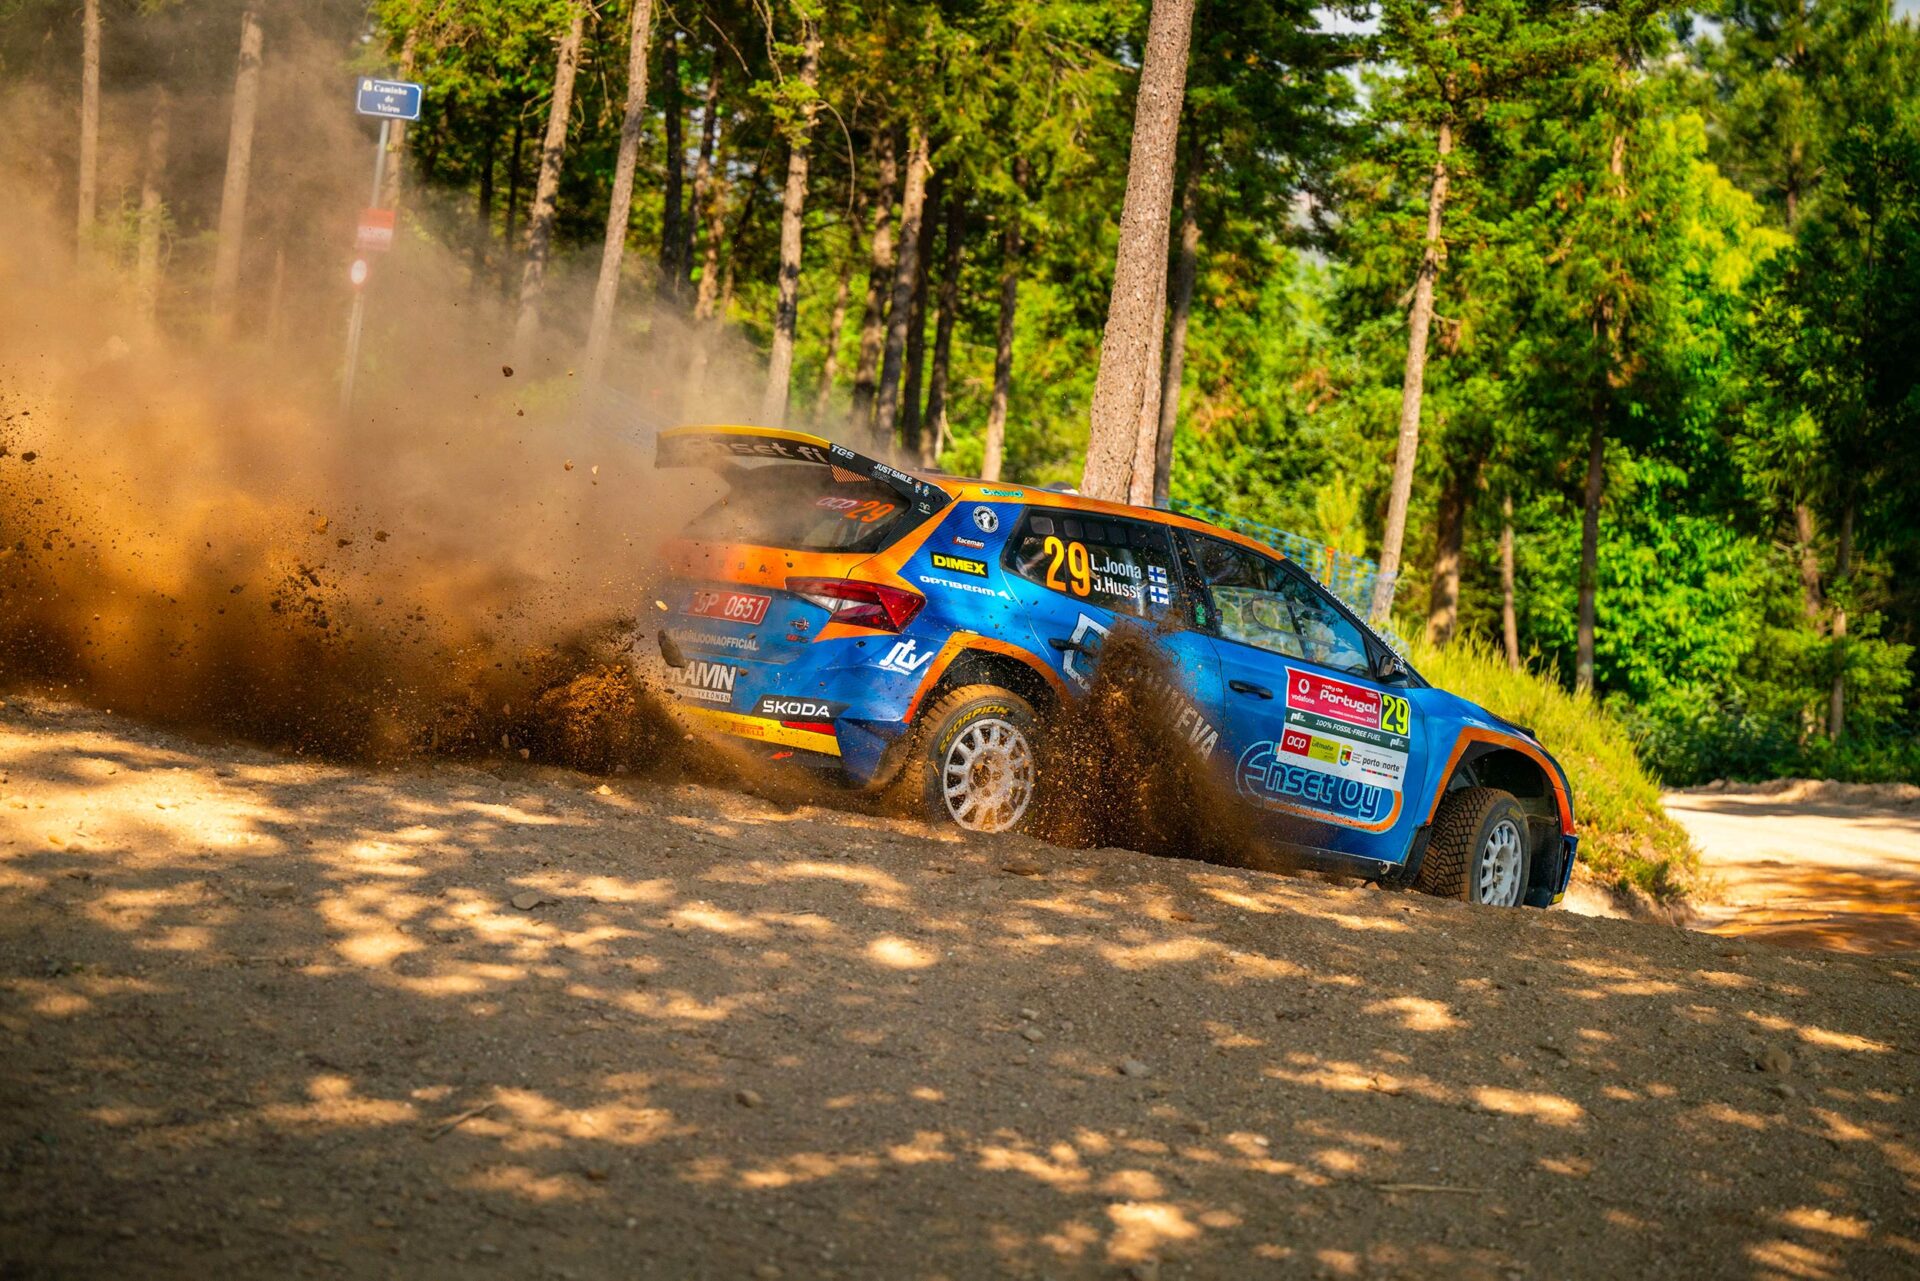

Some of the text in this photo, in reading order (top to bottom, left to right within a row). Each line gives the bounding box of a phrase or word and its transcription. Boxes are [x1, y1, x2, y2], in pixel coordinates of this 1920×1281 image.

[374, 84, 407, 95] Caminho
[384, 95, 394, 103] de
[831, 444, 855, 460] TGS
[873, 463, 892, 475] JUST
[891, 470, 913, 485] SMILE
[844, 500, 895, 523] 29
[956, 536, 985, 548] Raceman
[933, 555, 986, 576] DIMEX
[1043, 536, 1091, 597] 29
[1090, 553, 1142, 580] L.Joona
[1093, 576, 1142, 599] J.Hussi
[695, 593, 764, 620] SP 0651
[1291, 694, 1315, 705] vodafone
[1320, 689, 1378, 714] Portugal
[1381, 694, 1409, 735] 29
[939, 705, 1010, 755] SCORPION
[1316, 719, 1381, 741] 100% FOSSIL-FREE FUEL
[1286, 735, 1306, 750] acp
[1362, 757, 1380, 768] porto
[1382, 762, 1400, 773] norte
[1338, 777, 1382, 821] Oy
